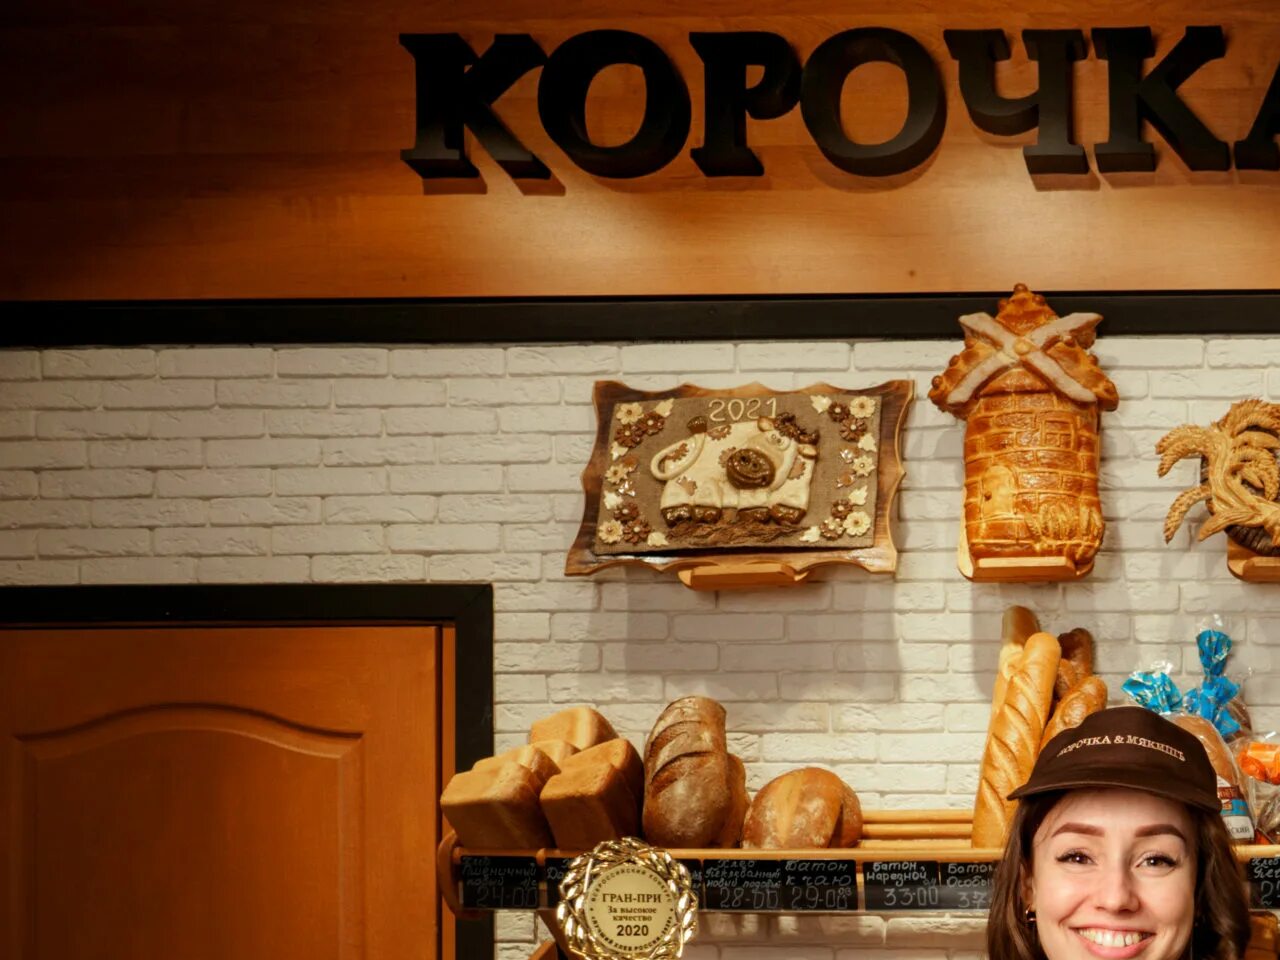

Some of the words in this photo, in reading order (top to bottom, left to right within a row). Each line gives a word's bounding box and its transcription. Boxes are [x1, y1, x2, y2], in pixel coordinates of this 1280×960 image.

[708, 397, 778, 423] 2021
[1113, 735, 1125, 745] &
[1126, 735, 1186, 762] МЯКИШЪ
[602, 893, 662, 903] ГРАН-ПРИ
[720, 887, 778, 908] 28-00
[883, 885, 939, 906] 33-00
[608, 906, 618, 914] За
[620, 906, 657, 914] высокое
[616, 924, 649, 937] 2020
